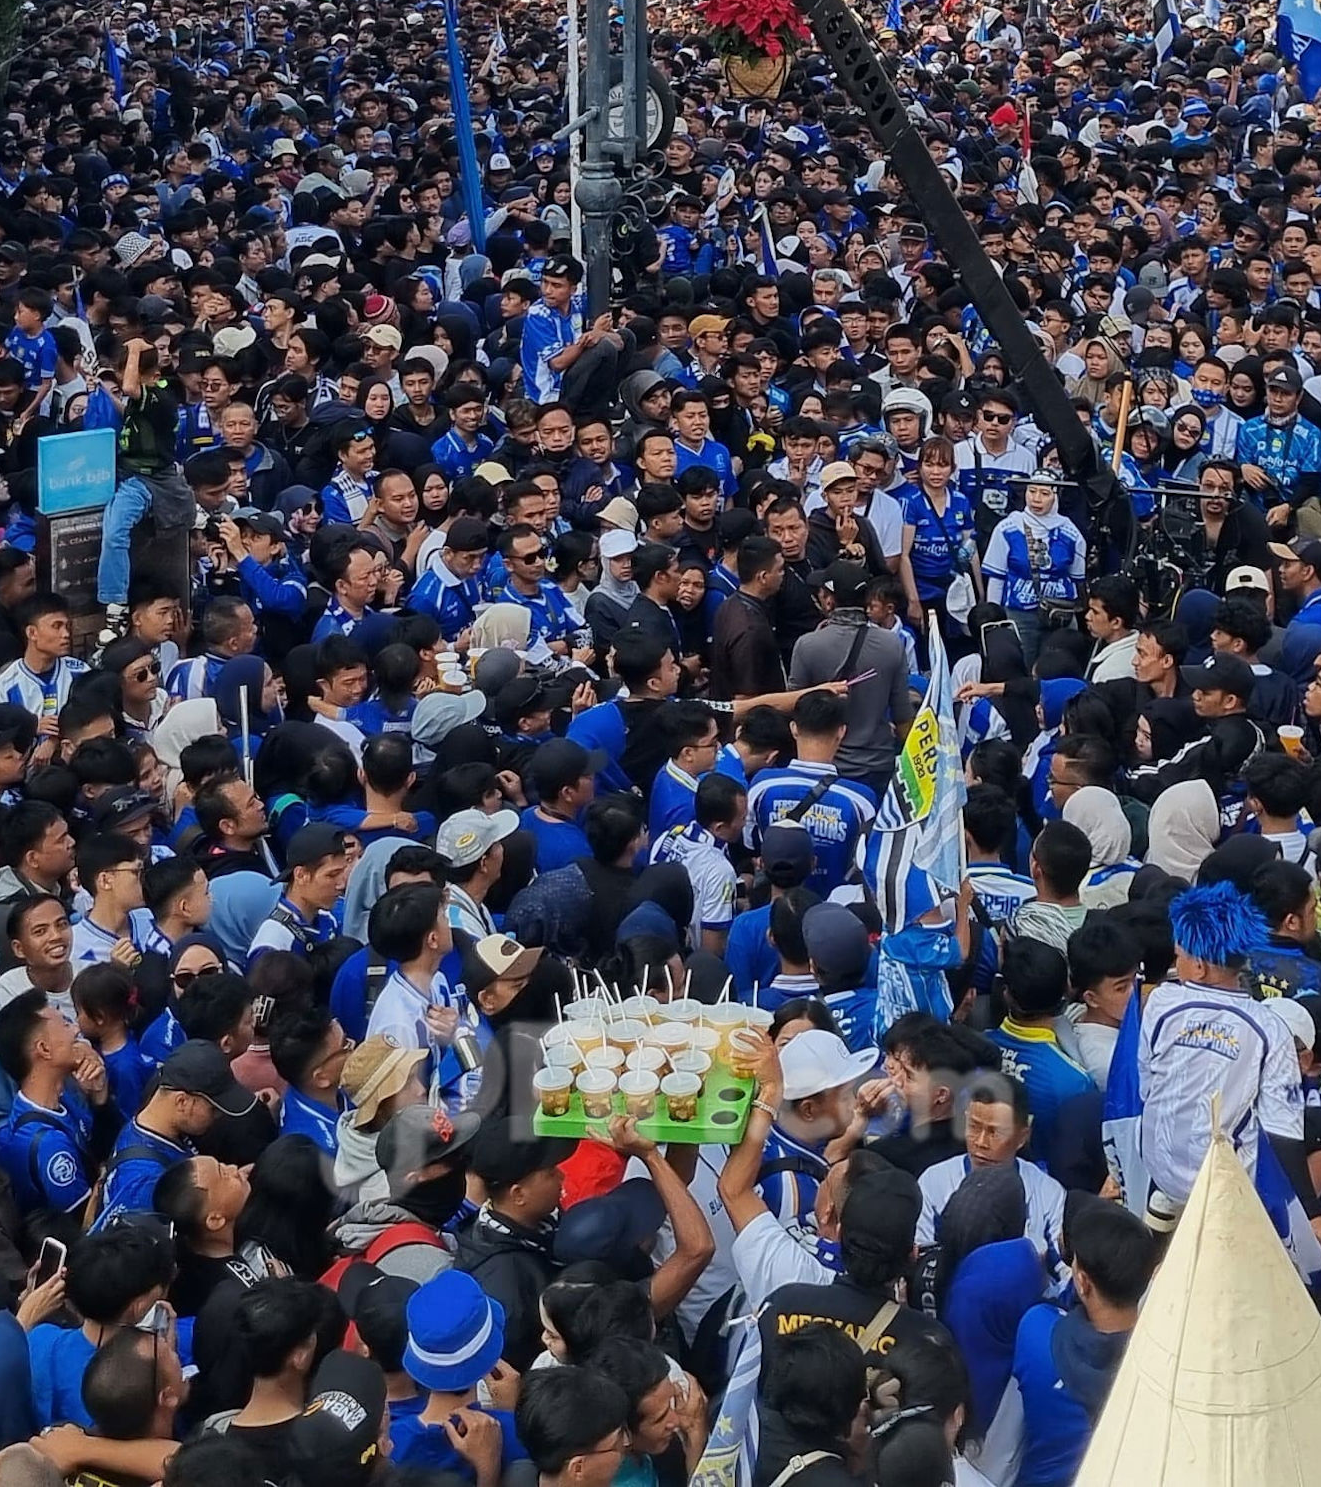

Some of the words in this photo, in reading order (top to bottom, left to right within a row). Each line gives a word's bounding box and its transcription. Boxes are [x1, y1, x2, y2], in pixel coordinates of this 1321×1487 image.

[49, 470, 84, 490] bank
[86, 468, 111, 485] bjb
[912, 754, 926, 779] 1933
